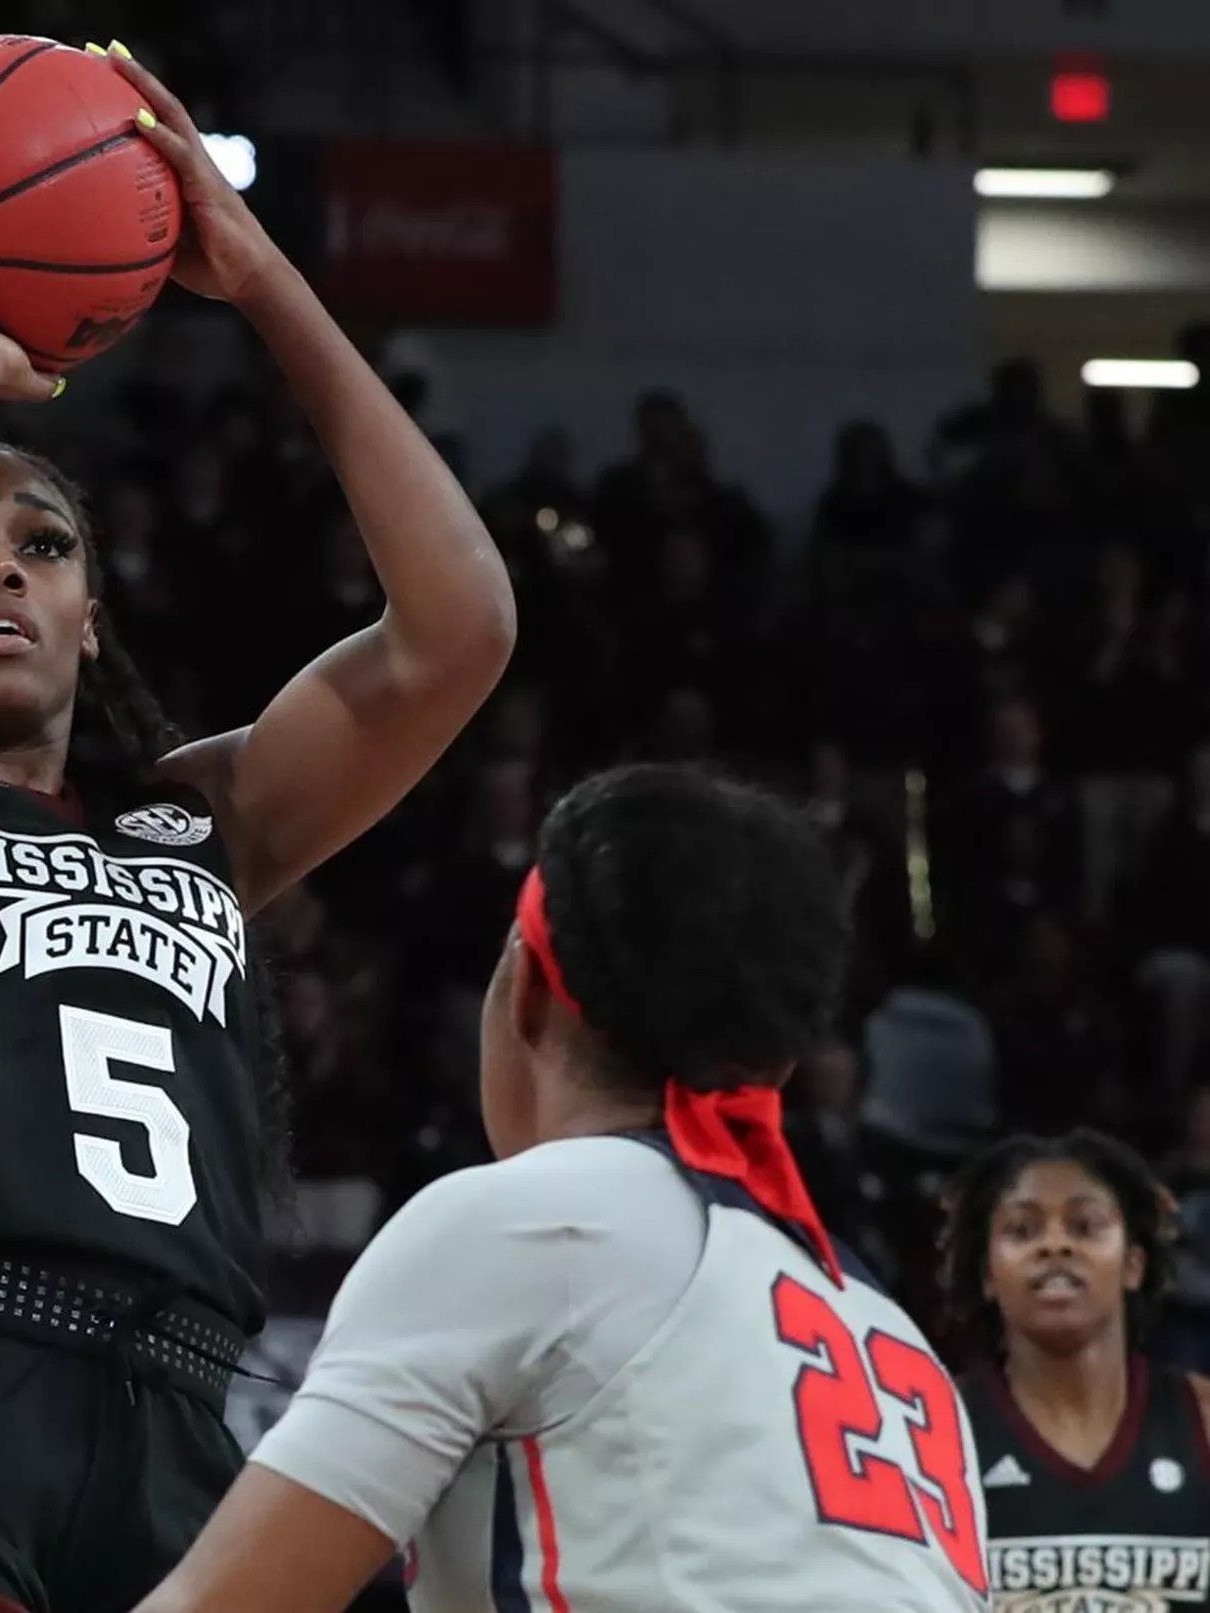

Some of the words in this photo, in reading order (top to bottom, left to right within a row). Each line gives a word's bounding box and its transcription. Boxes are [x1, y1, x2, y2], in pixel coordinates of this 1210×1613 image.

[45, 915, 198, 990] STATE
[58, 1003, 198, 1227] 5
[770, 1269, 989, 1602] 23
